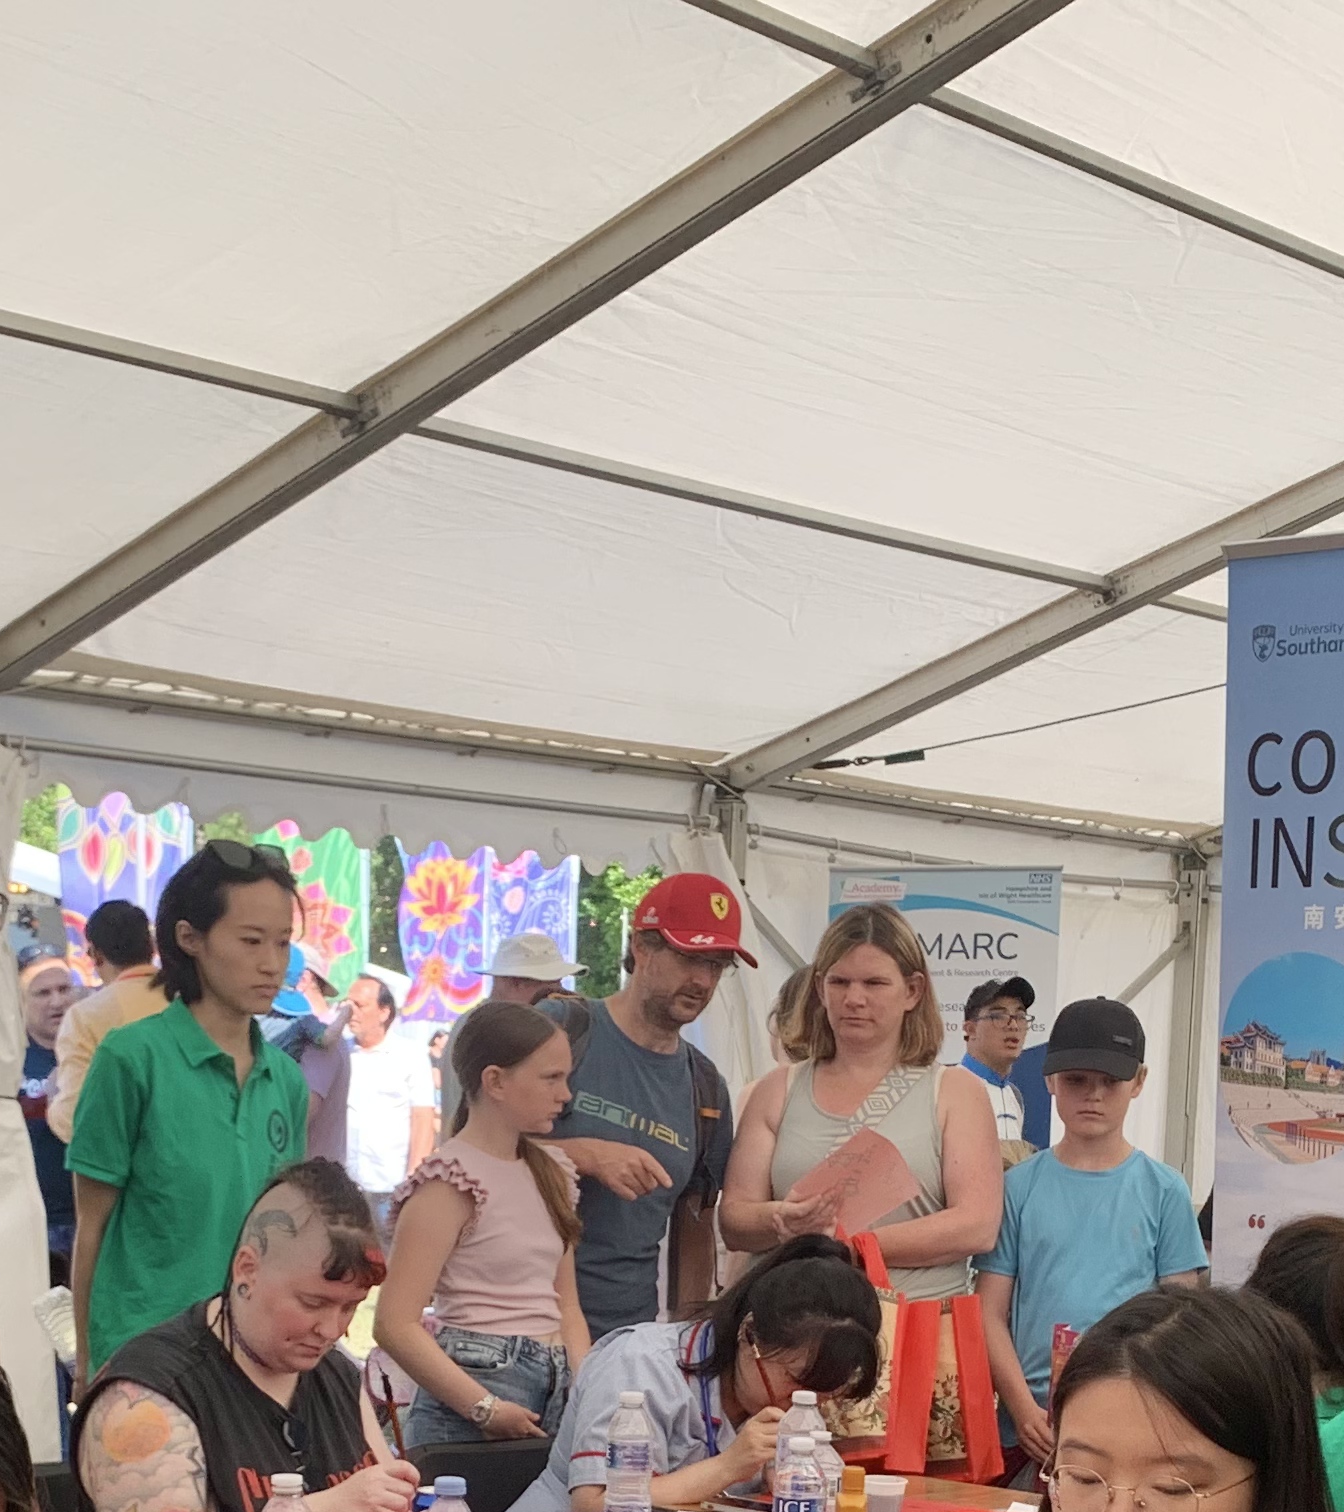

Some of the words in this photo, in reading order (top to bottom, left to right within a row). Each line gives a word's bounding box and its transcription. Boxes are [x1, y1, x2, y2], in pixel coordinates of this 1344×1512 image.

[1289, 622, 1344, 636] University
[1030, 874, 1052, 884] NHS
[917, 932, 1019, 961] MARC
[954, 968, 990, 977] Research
[946, 1022, 958, 1032] to
